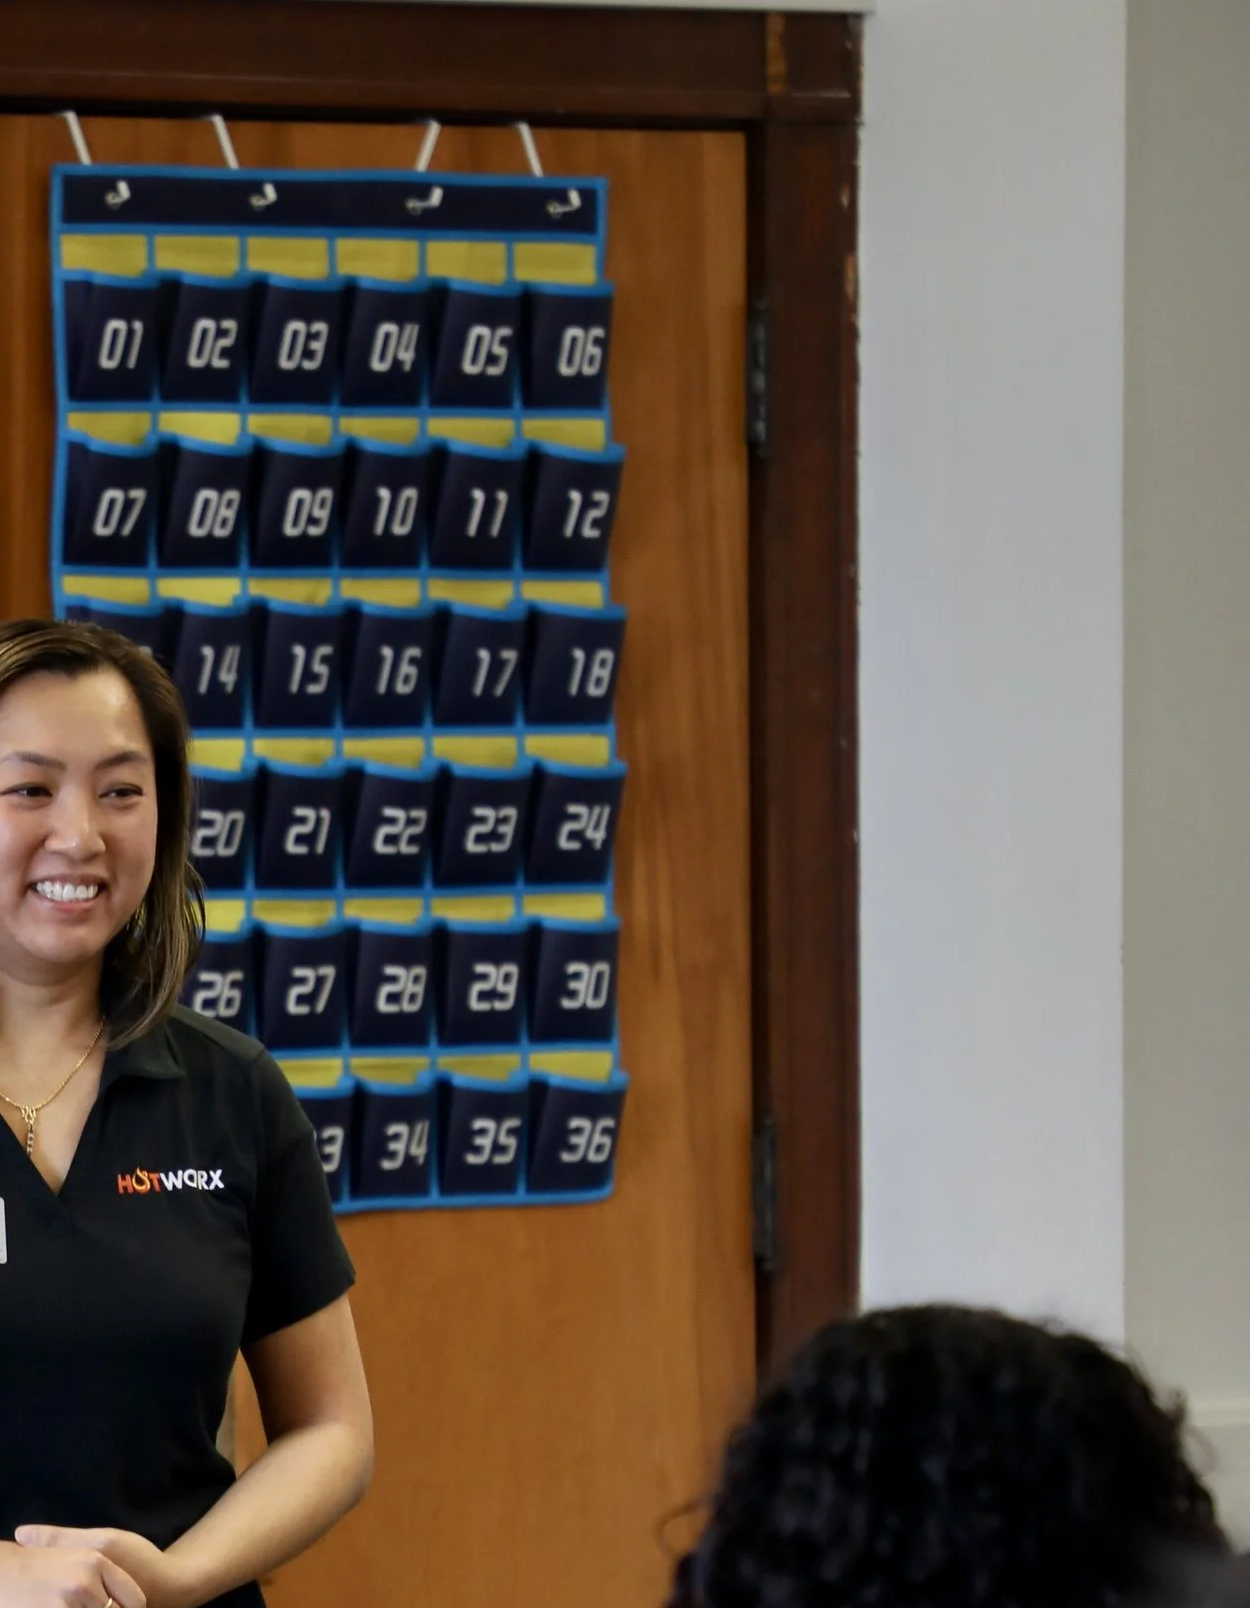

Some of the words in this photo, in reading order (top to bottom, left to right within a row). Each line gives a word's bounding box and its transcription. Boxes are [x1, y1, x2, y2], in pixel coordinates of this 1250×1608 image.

[99, 319, 144, 370] 01
[187, 318, 238, 369] 02
[278, 320, 329, 371] 03
[370, 322, 419, 372] 04
[461, 325, 513, 376] 05
[557, 326, 606, 377] 06
[93, 489, 147, 537] 07
[187, 488, 241, 538] 08
[282, 488, 334, 537] 09
[374, 487, 419, 536] 10
[467, 488, 509, 537] 11
[564, 490, 610, 538] 12
[198, 646, 240, 694] 14
[289, 644, 334, 694] 15
[377, 646, 422, 695] 16
[473, 648, 518, 697] 17
[569, 648, 615, 697] 18
[190, 809, 245, 857] 20
[285, 807, 331, 855] 21
[372, 806, 427, 855] 22
[464, 806, 519, 854] 23
[557, 804, 611, 851] 24
[192, 970, 244, 1020] 26
[286, 965, 337, 1015] 27
[375, 965, 427, 1014] 28
[467, 963, 520, 1012] 29
[560, 963, 611, 1011] 30
[314, 1126, 345, 1173] 3
[382, 1121, 430, 1170] 34
[465, 1118, 522, 1165] 35
[559, 1116, 617, 1164] 36
[117, 1166, 225, 1195] HOTWORX
